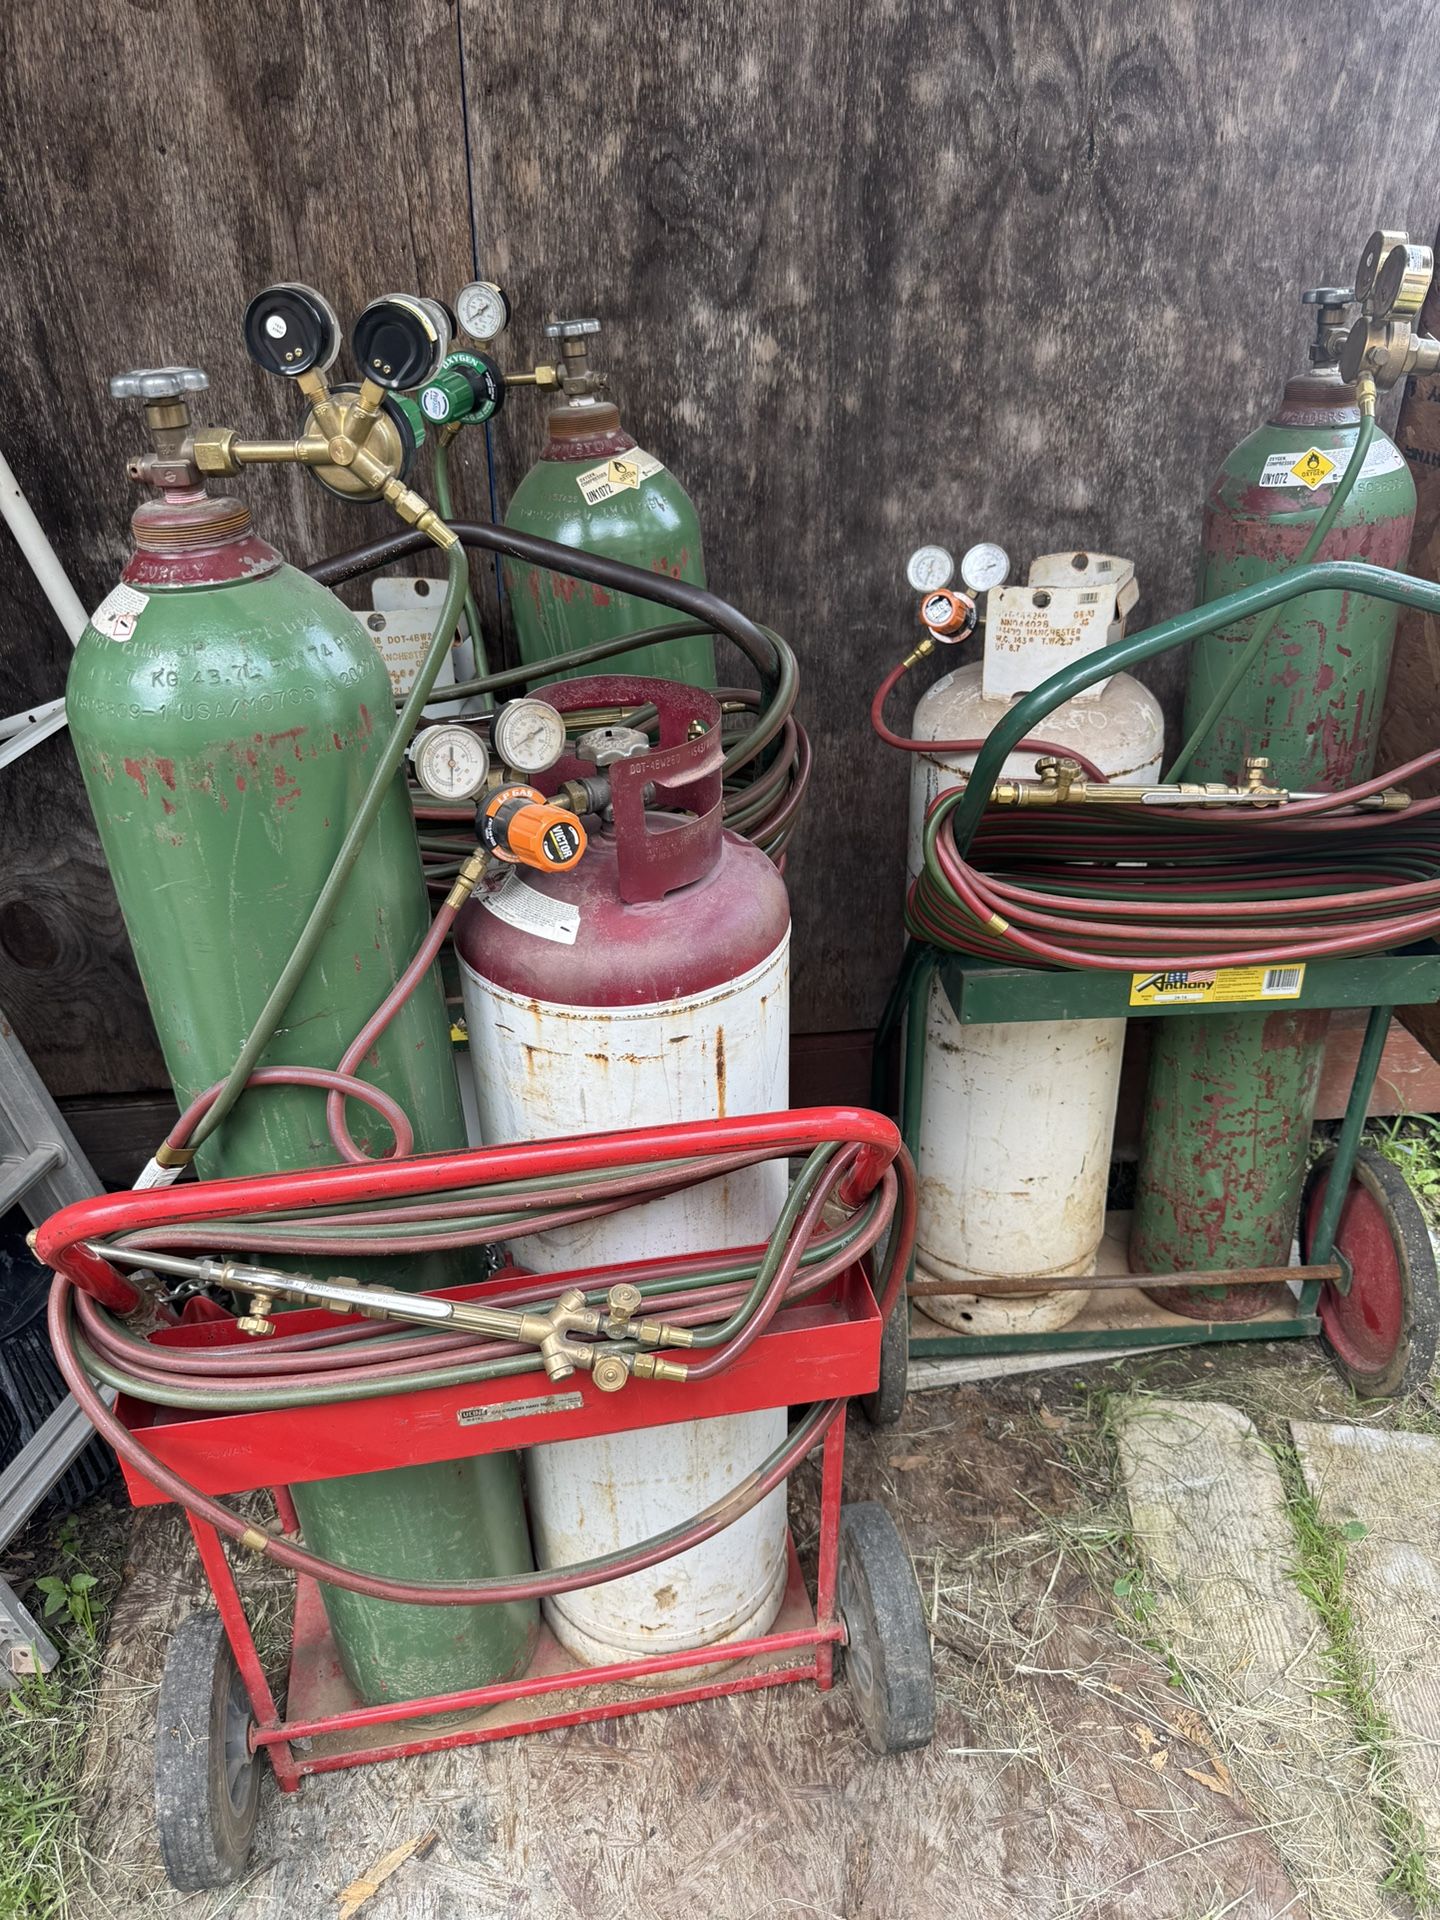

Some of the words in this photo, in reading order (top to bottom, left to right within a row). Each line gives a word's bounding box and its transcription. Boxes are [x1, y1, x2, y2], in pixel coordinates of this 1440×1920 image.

[443, 354, 479, 369] OXYGEN
[1261, 472, 1288, 485] UN1072
[1301, 470, 1325, 478] OXYGEN
[586, 483, 614, 503] UN1072
[388, 633, 432, 645] DOT-4BW2
[151, 667, 179, 688] KG
[497, 792, 510, 805] LP
[511, 788, 534, 798] GAS
[551, 825, 573, 859] VICTOR
[1135, 973, 1214, 992] Anthony
